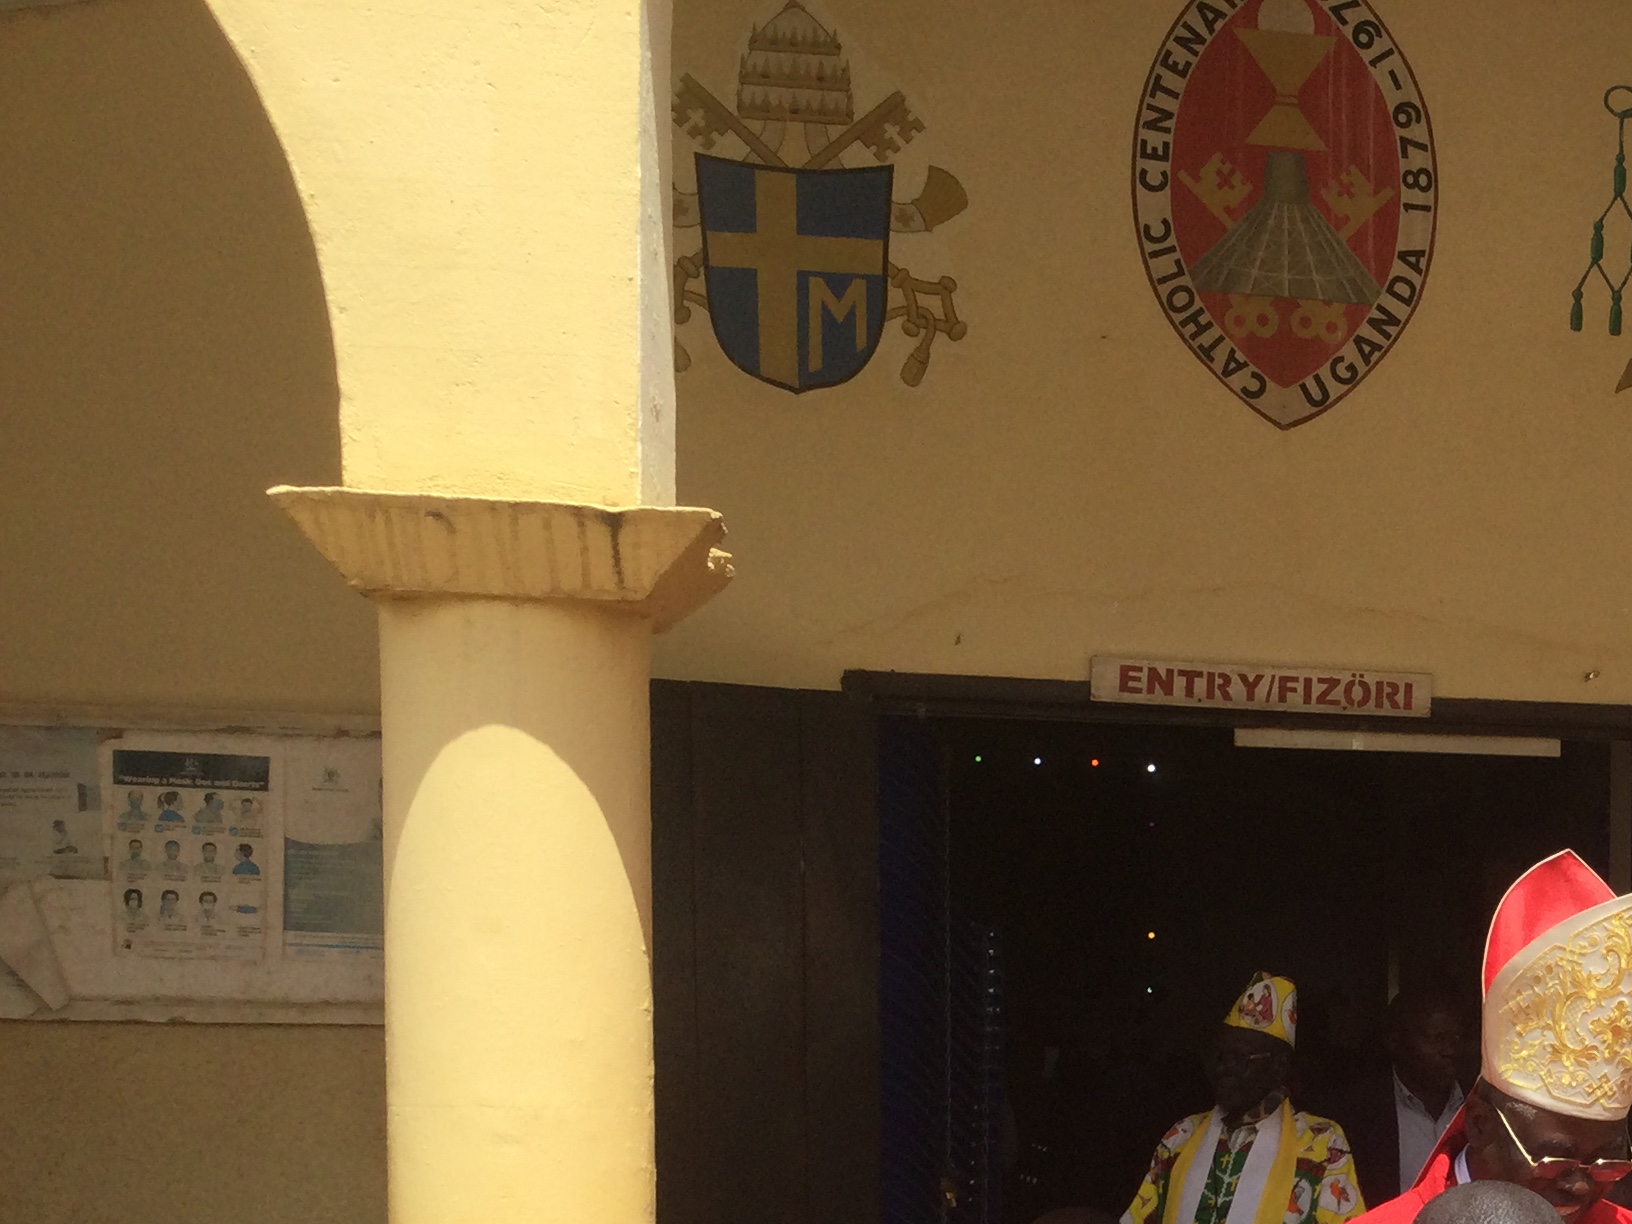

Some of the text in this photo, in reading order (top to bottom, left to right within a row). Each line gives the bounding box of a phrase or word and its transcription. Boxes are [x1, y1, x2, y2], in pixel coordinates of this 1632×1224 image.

[808, 276, 867, 372] M
[1139, 0, 1268, 401] CATHOLIC CENTENA
[1300, 0, 1433, 408] UGANDA 1879-197
[1118, 664, 1414, 711] ENTRY/FIZÖRI
